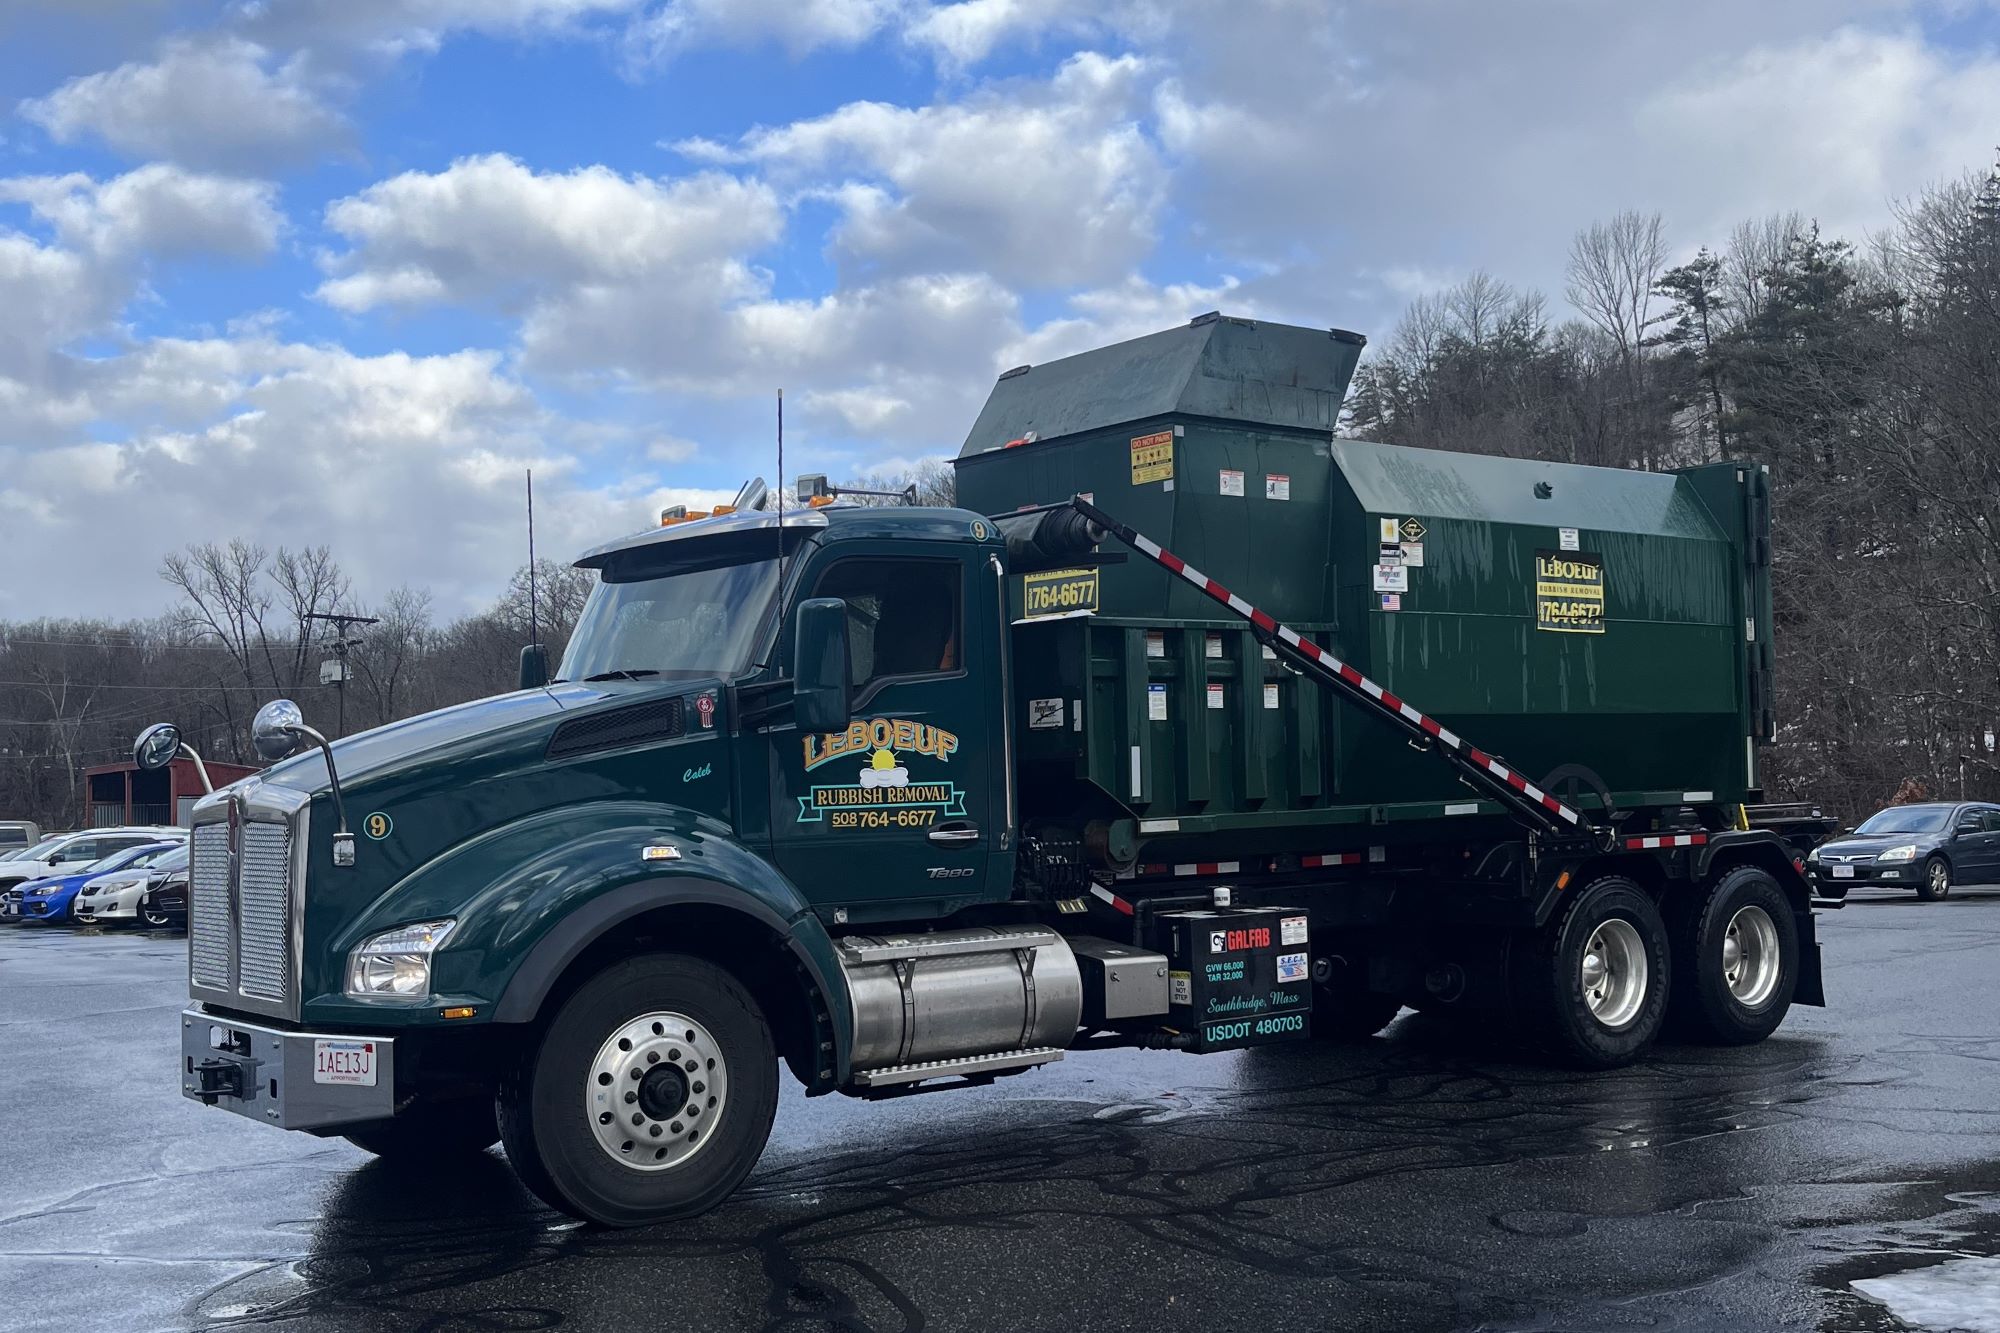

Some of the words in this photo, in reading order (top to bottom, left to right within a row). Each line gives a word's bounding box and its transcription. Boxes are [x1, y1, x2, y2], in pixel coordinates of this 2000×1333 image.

[973, 521, 985, 539] 9
[801, 718, 959, 772] LEBOEUF
[683, 763, 712, 783] Caleb
[817, 787, 882, 806] RUBBISH
[888, 786, 949, 803] REMOVAL
[370, 815, 386, 837] 9
[832, 812, 857, 825] 508
[859, 810, 936, 828] 764-6677
[926, 867, 975, 879] T880
[1227, 928, 1271, 952] GALFAB
[1206, 963, 1222, 973] GVW
[1208, 973, 1221, 982] TAR
[1222, 971, 1243, 981] 32,000
[1207, 995, 1267, 1014] Southbridge,
[1270, 991, 1300, 1004] Mass
[1207, 1022, 1251, 1042] USDOT
[1256, 1015, 1303, 1034] 480703
[318, 1052, 369, 1074] 1AE13J
